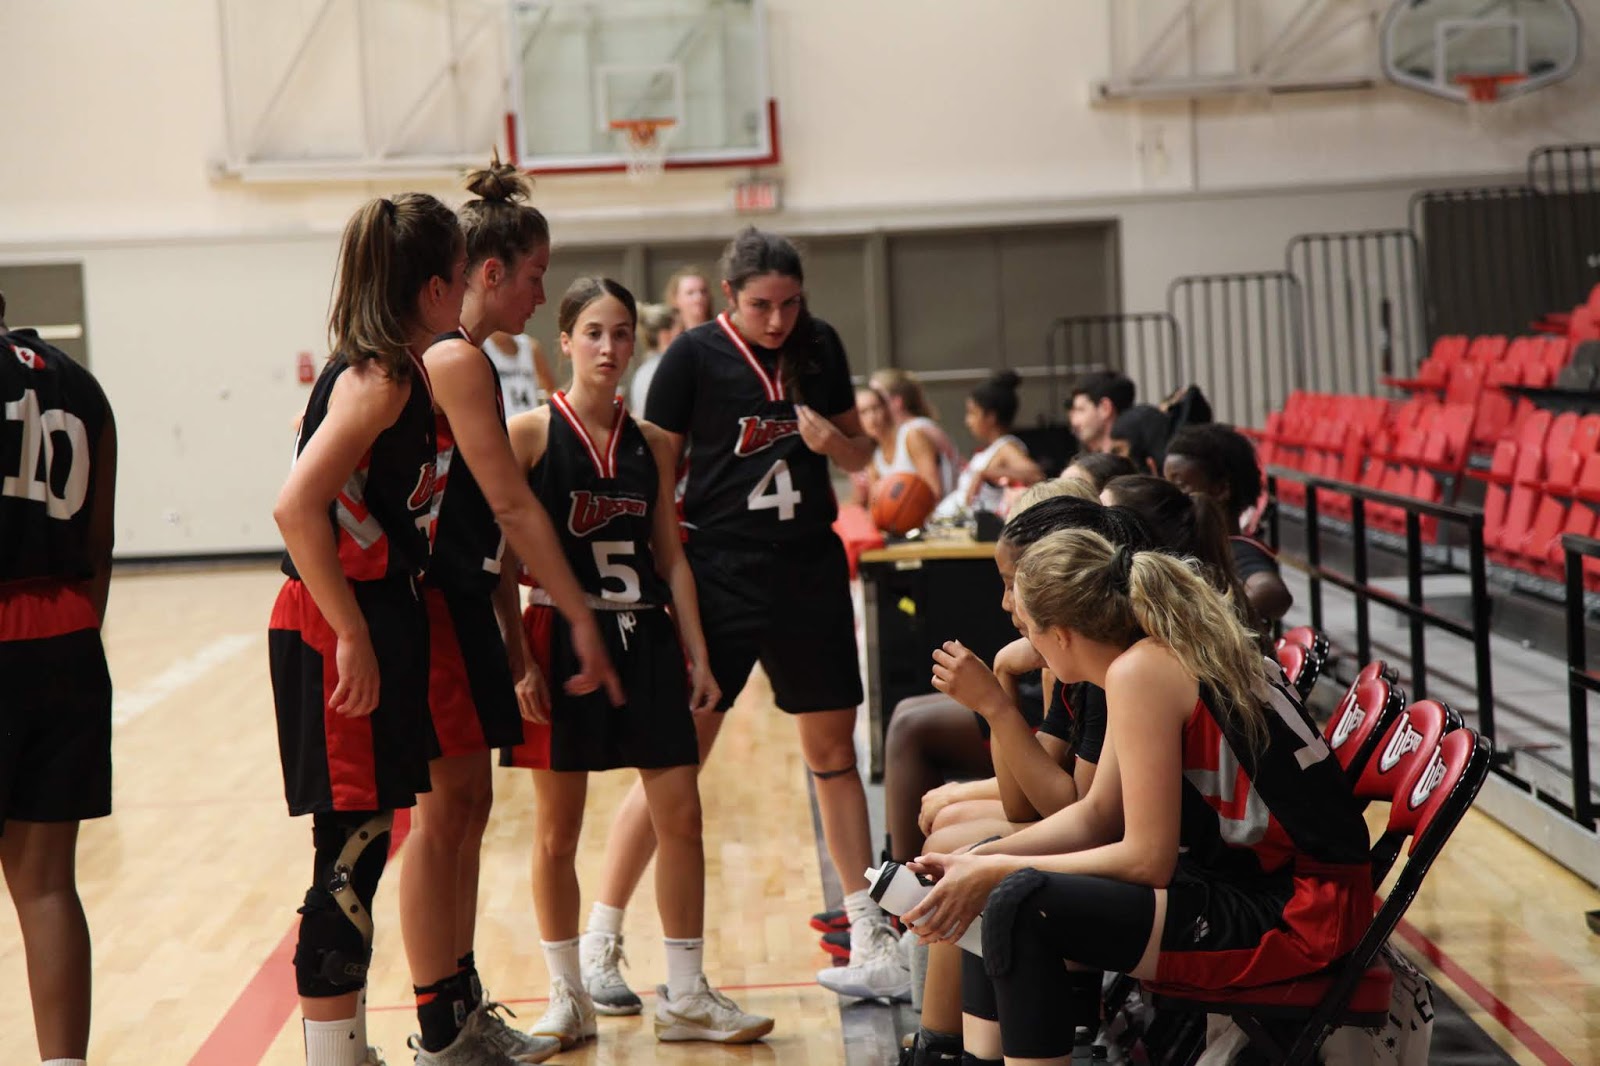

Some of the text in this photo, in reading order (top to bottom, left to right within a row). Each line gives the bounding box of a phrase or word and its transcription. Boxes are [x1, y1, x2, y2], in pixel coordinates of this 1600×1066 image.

[2, 388, 90, 521] 10
[747, 459, 801, 521] 4
[591, 540, 642, 604] 5
